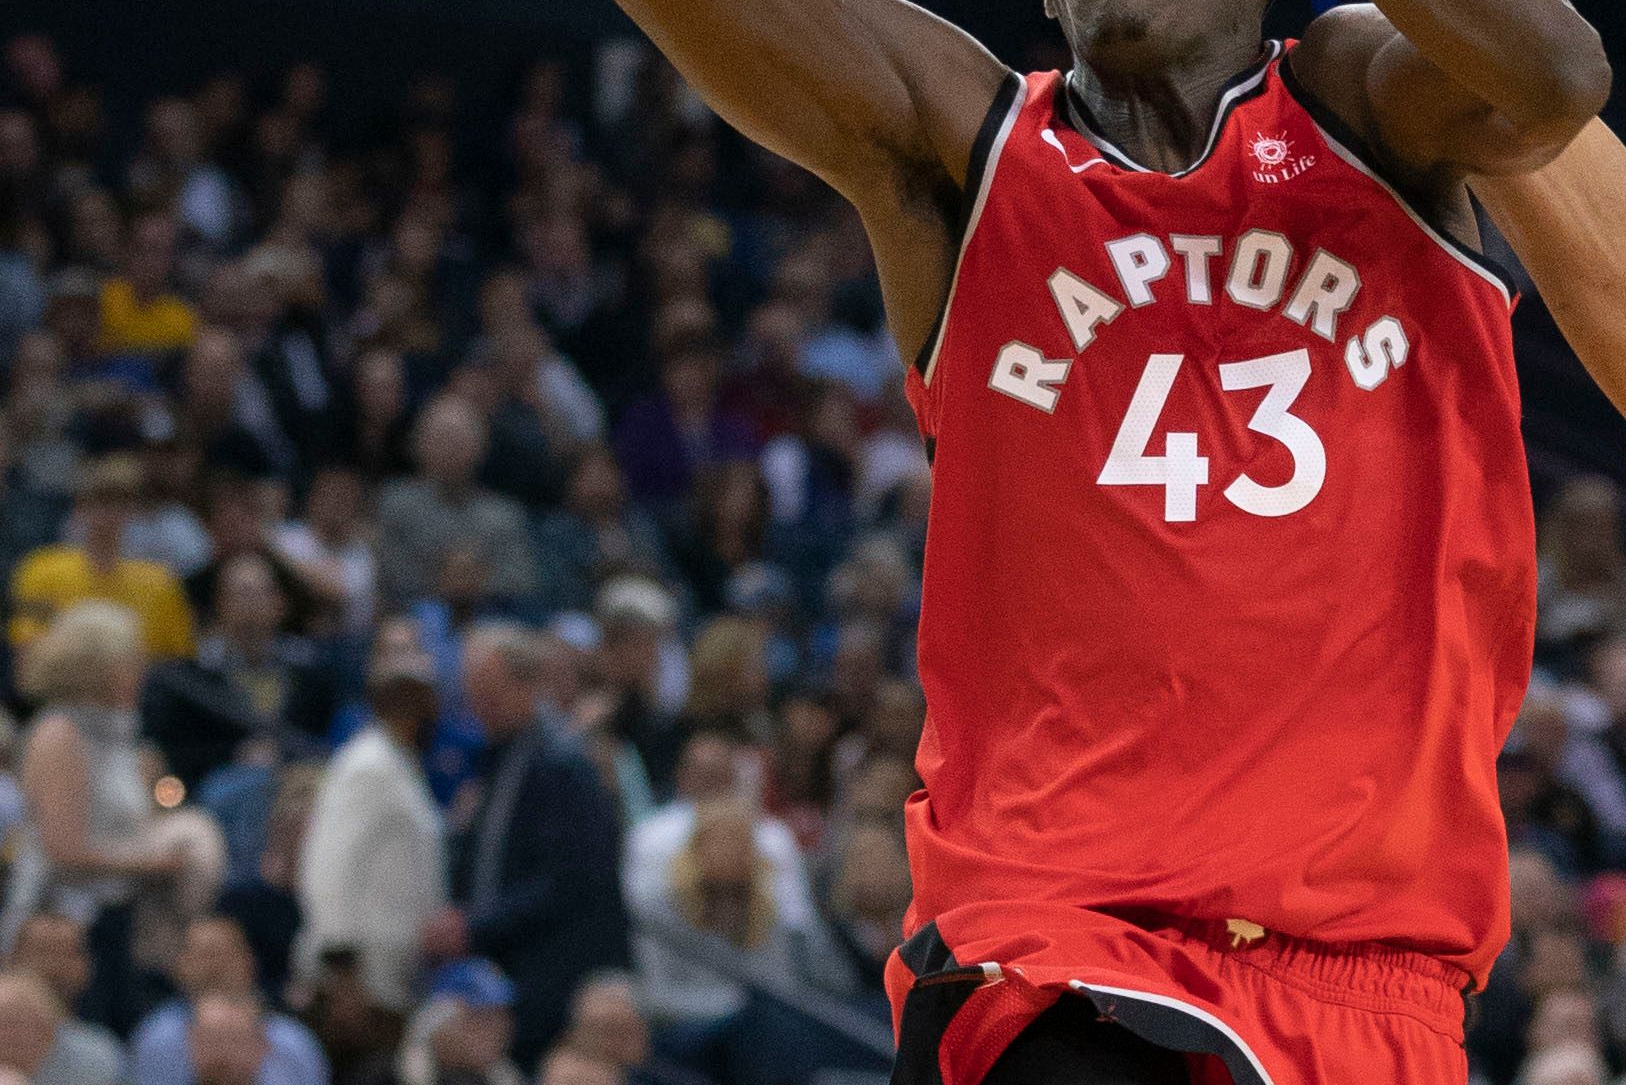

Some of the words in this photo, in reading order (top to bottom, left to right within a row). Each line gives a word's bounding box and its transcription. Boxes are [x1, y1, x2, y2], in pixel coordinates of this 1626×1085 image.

[1281, 155, 1316, 180] Life
[987, 228, 1410, 415] RAPTORS
[1096, 348, 1326, 522] 43
